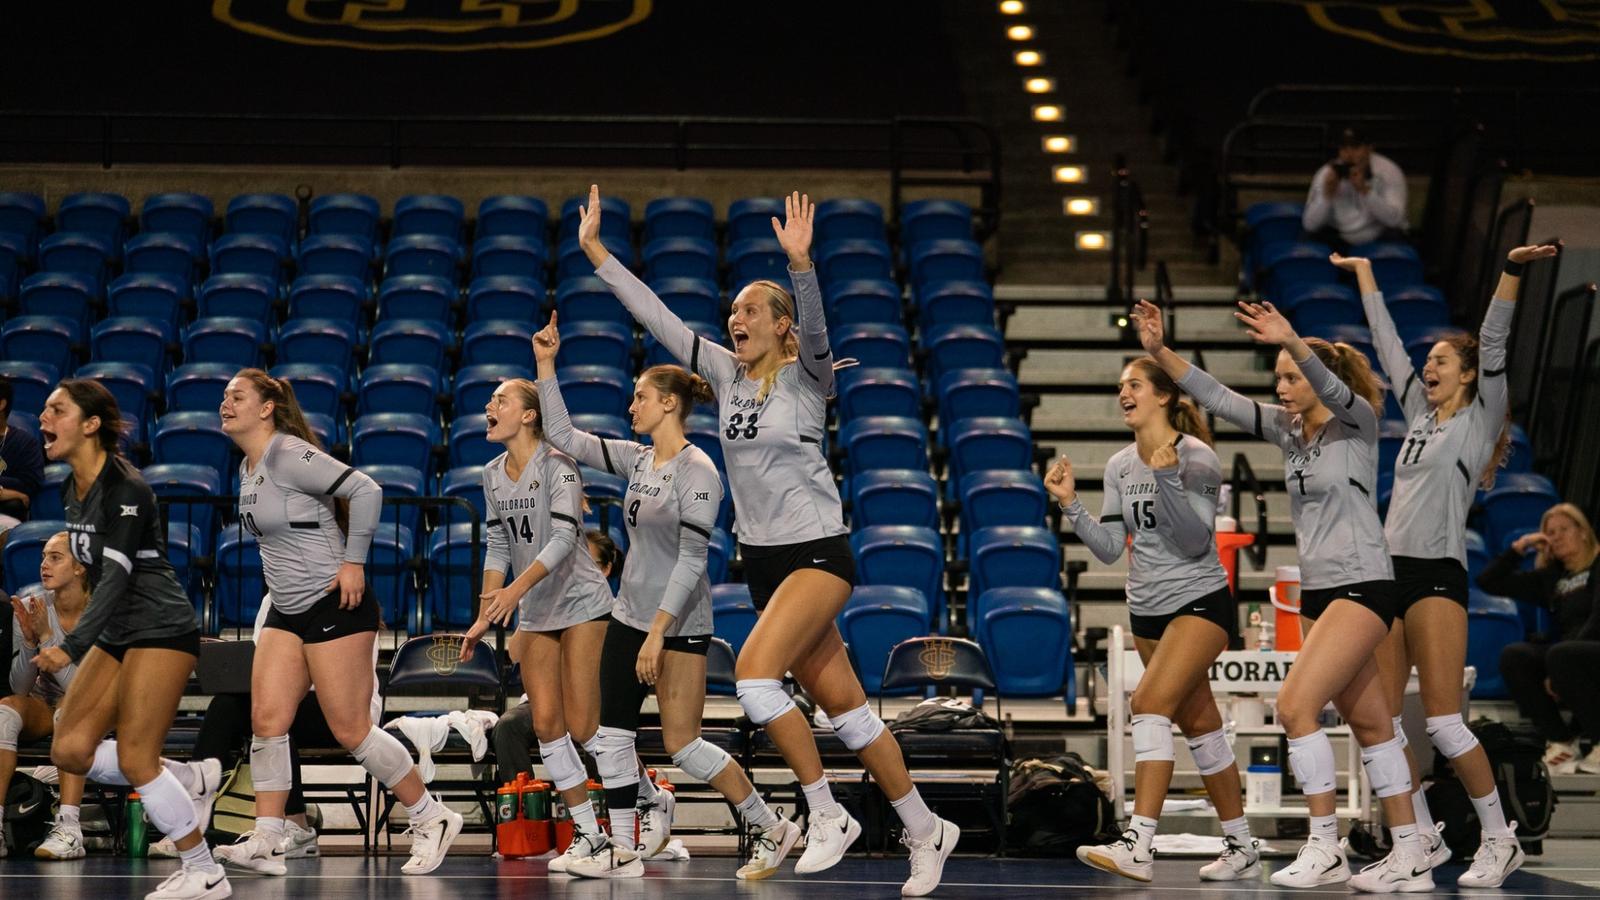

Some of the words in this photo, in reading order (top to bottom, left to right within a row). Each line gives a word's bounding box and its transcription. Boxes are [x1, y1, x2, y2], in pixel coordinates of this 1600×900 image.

[726, 412, 759, 440] 33
[1402, 437, 1427, 465] 11
[1125, 483, 1160, 496] COLORAD
[497, 497, 536, 511] COLORADO
[628, 499, 641, 528] 9
[1131, 500, 1157, 530] 15
[506, 514, 534, 544] 14
[70, 531, 94, 565] 13
[1209, 660, 1293, 682] TORA
